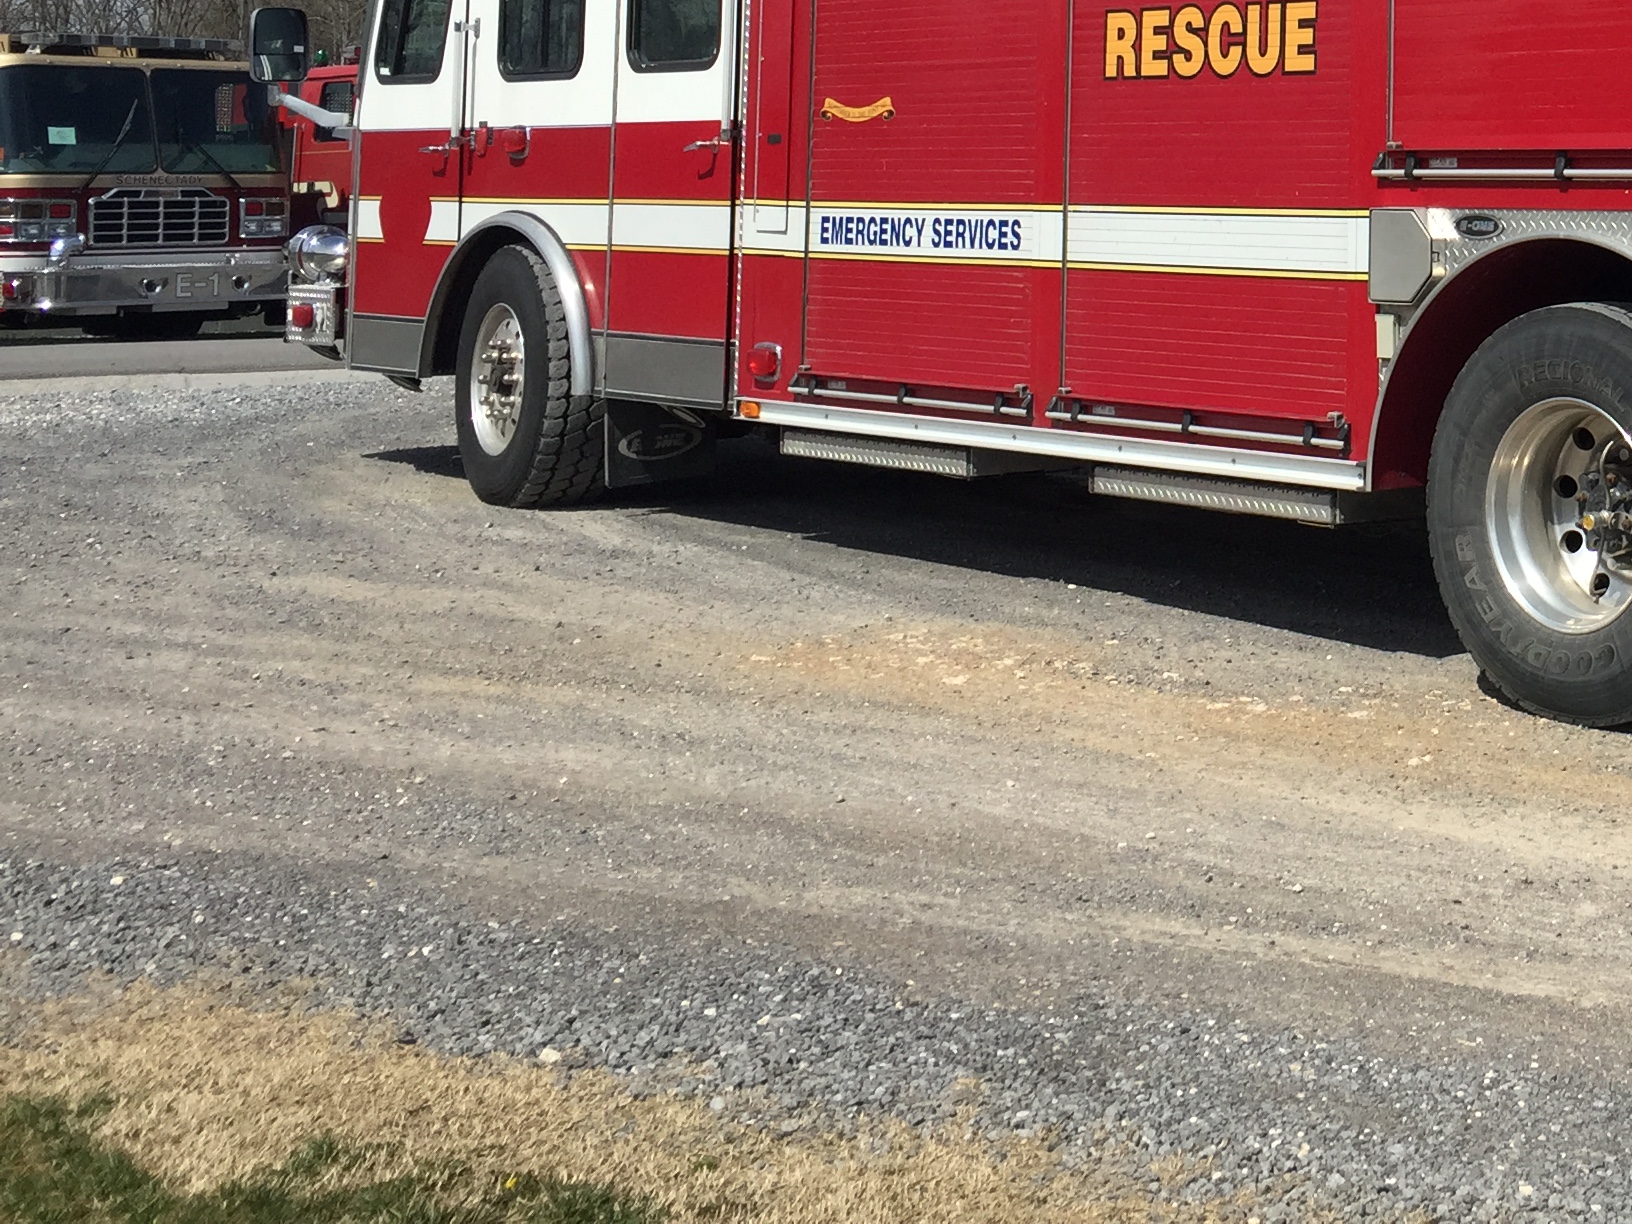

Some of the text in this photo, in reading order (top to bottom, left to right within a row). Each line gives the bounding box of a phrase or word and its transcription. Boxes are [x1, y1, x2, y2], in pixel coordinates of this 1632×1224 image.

[116, 175, 204, 185] SCHENECTADY
[820, 215, 1022, 251] EMERGENCY SERVICES
[1459, 219, 1496, 232] E-ONE
[176, 273, 221, 298] E-1
